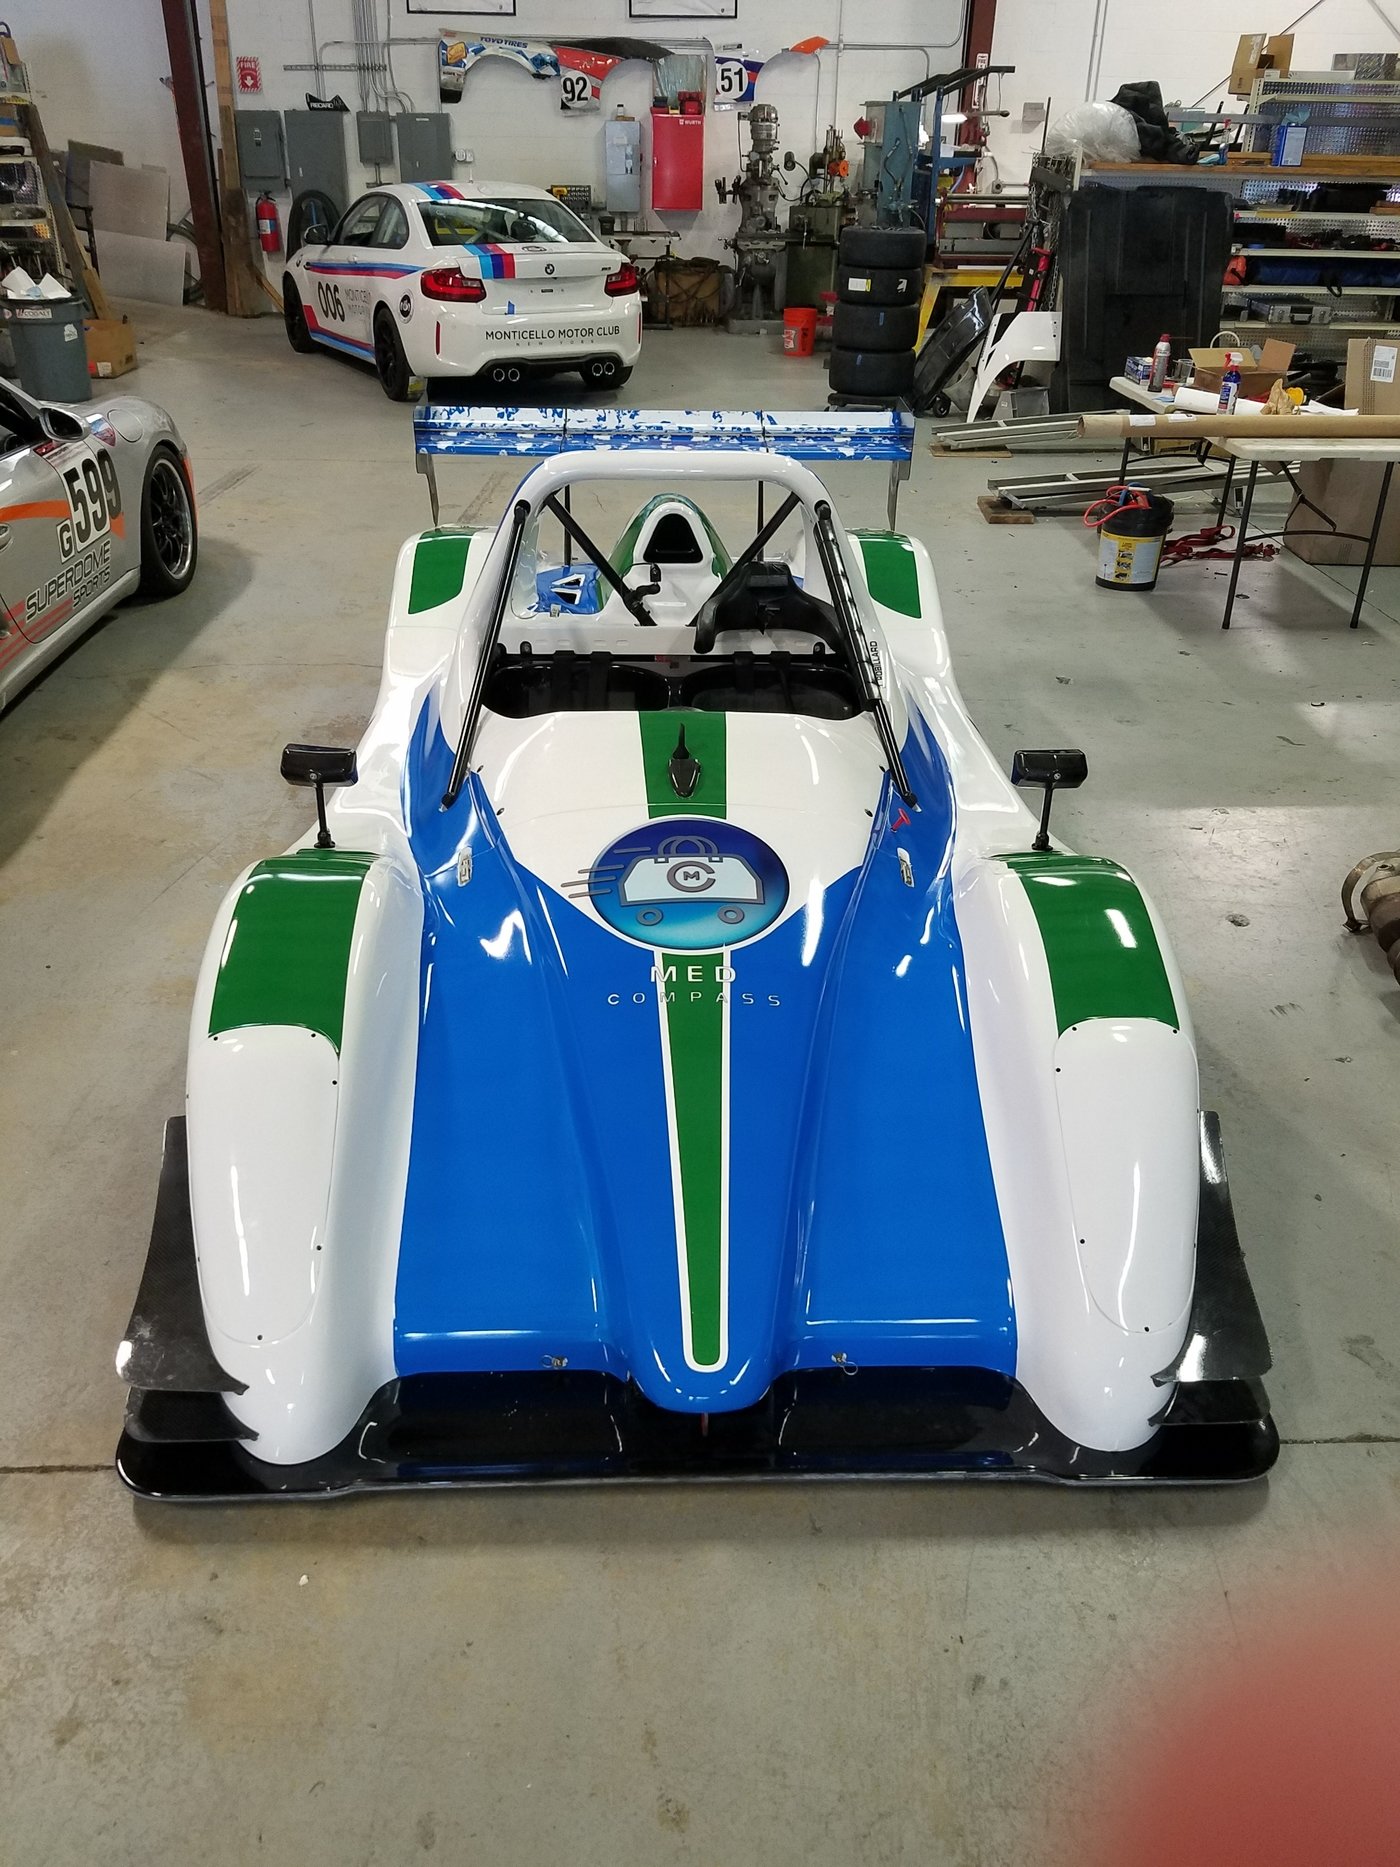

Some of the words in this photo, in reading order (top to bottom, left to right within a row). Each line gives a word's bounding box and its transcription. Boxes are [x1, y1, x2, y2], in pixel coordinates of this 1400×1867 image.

[480, 36, 504, 44] TOYO
[504, 39, 529, 49] TIRES
[240, 61, 256, 69] FIRE
[562, 76, 589, 102] 92
[721, 67, 743, 92] 51
[317, 281, 345, 322] 006
[485, 329, 555, 340] MONTICELLO
[558, 327, 594, 339] MOTOR
[596, 325, 620, 336] CLUB
[63, 448, 122, 544] 599
[59, 523, 73, 559] G
[26, 540, 111, 621] SUPERDOME
[73, 566, 111, 607] SPORTS
[650, 966, 736, 982] MED
[607, 991, 780, 1006] COMPASS
